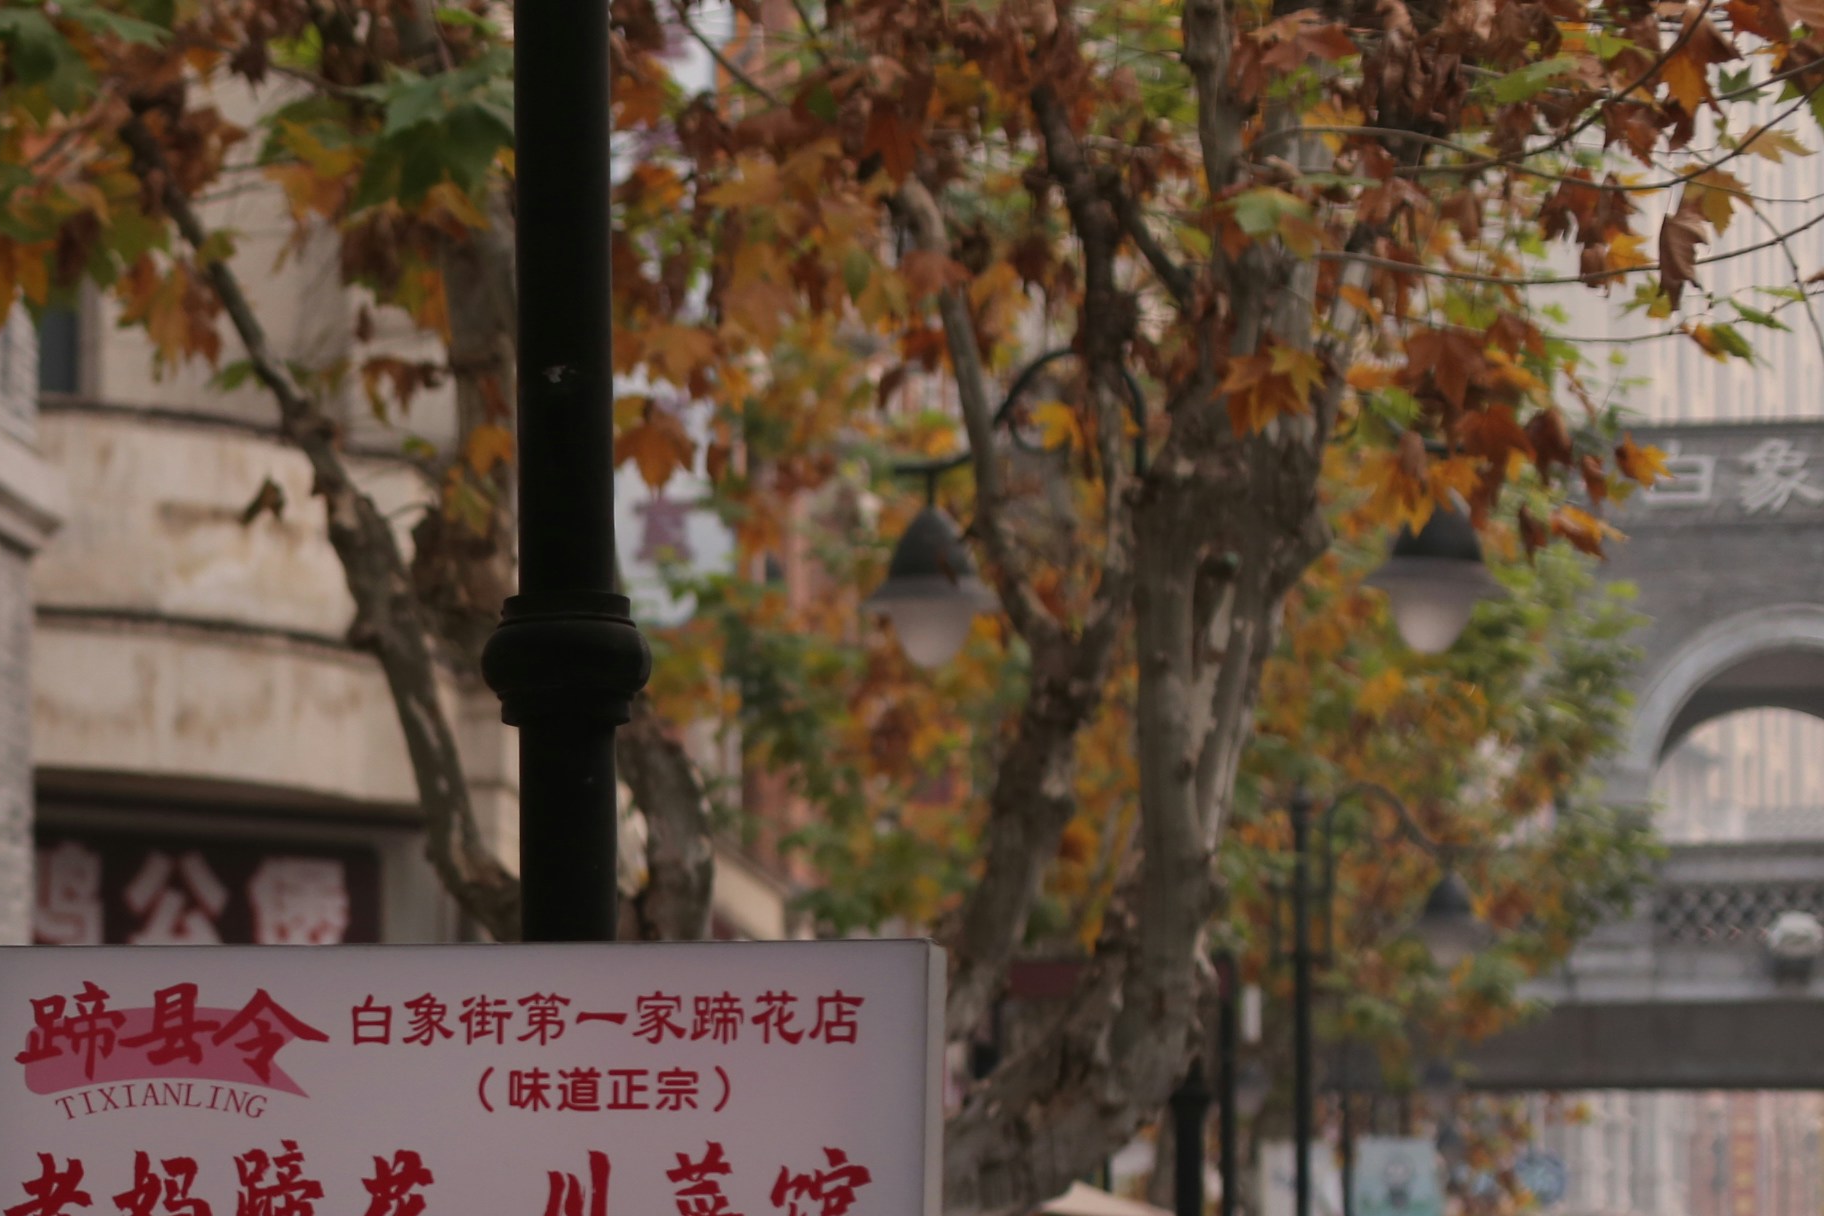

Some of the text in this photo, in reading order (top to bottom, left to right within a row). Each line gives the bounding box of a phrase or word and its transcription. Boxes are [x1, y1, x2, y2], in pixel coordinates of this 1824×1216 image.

[14, 980, 330, 1085] 蹄县令
[349, 990, 867, 1048] 白象街第一家蹄花店
[54, 1081, 269, 1121] TIXIANLING
